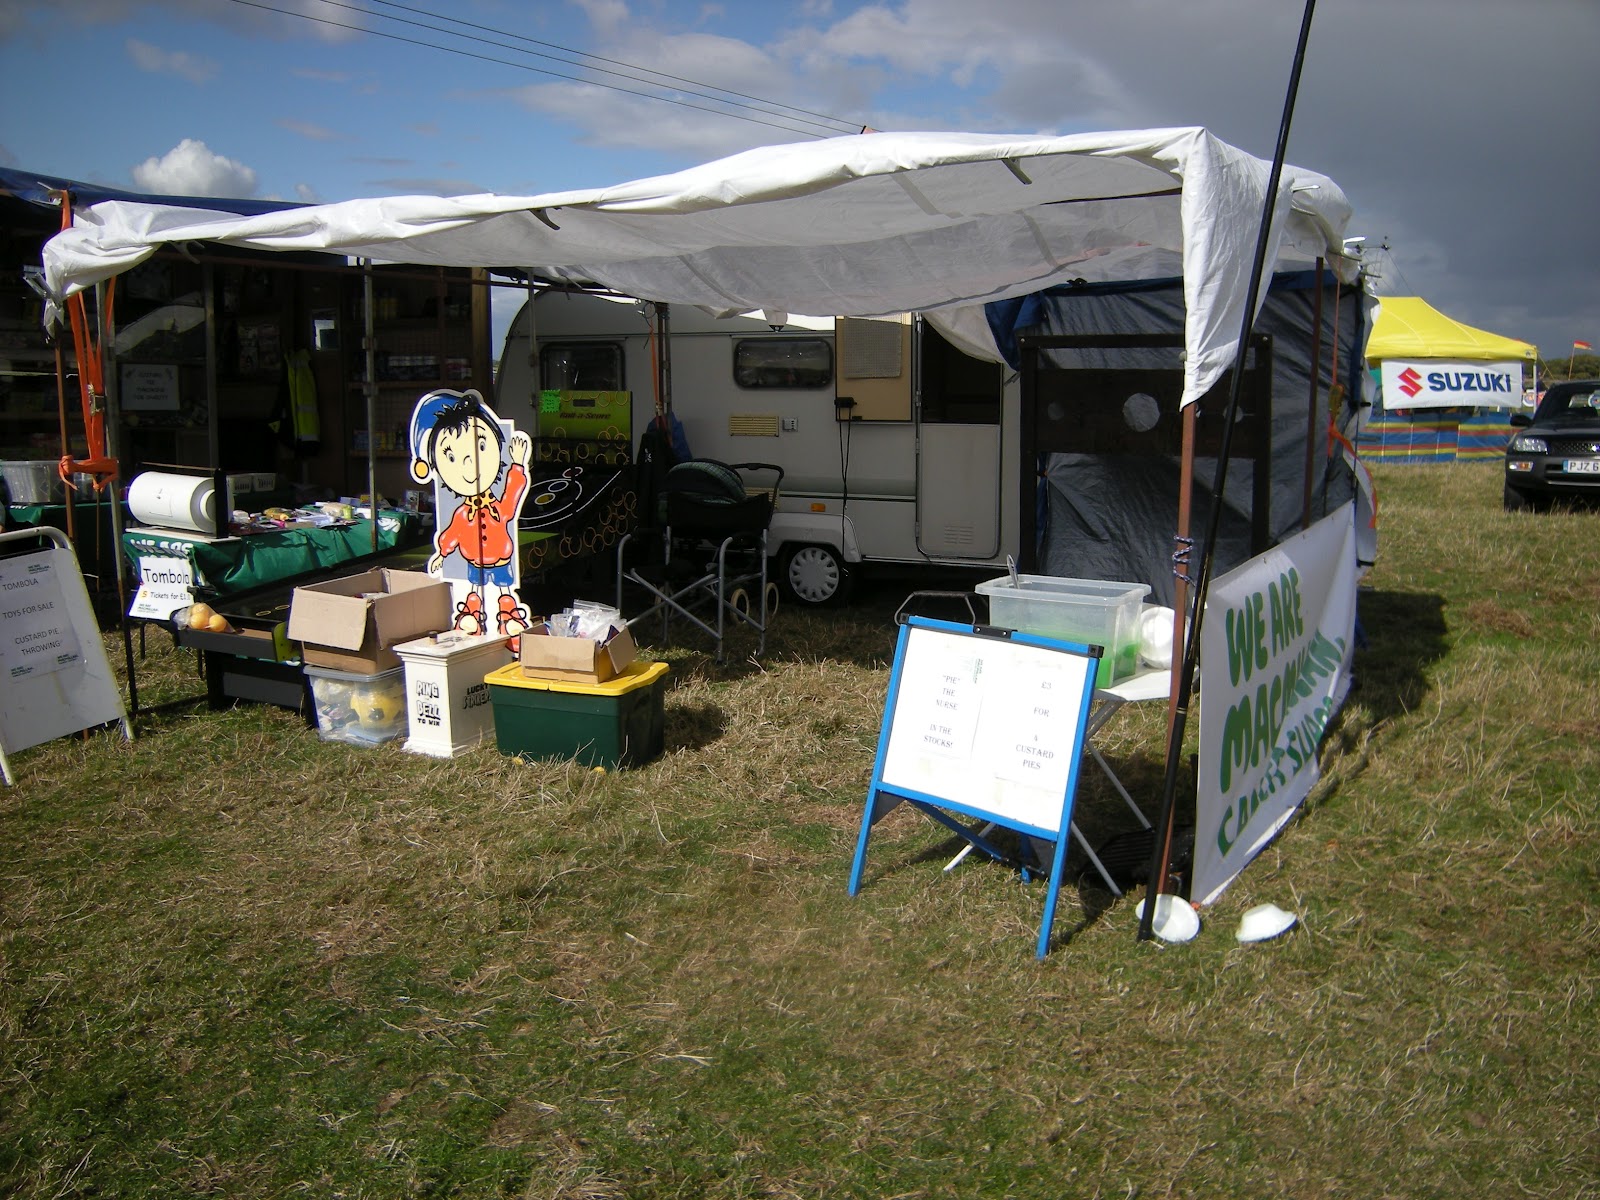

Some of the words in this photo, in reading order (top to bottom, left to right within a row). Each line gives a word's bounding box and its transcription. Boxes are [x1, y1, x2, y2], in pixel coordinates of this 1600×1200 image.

[1427, 372, 1512, 393] SUZUKI
[1569, 462, 1590, 471] PJZ
[143, 567, 190, 585] Tombola
[2, 577, 39, 591] TOMBOLA
[150, 591, 169, 600] Tickets
[170, 592, 179, 600] for
[2, 609, 22, 620] TOYS
[22, 605, 37, 615] FOR
[37, 601, 54, 612] SALE
[1225, 591, 1268, 688] WE
[1268, 567, 1304, 658] ARE
[15, 631, 48, 645] CUSTARD
[48, 628, 59, 636] PIE
[21, 640, 61, 656] THROWING
[416, 680, 440, 698] RING
[942, 687, 956, 697] THE
[1041, 681, 1052, 690] £3
[416, 699, 441, 720] BELL
[936, 699, 958, 710] NURSE
[1033, 706, 1050, 718] FOR
[417, 717, 426, 725] TO
[929, 723, 937, 731] IN
[938, 725, 953, 735] THE
[923, 735, 953, 748] STOCKS!
[1015, 744, 1054, 759] CUSTARD
[1022, 759, 1041, 769] PIES
